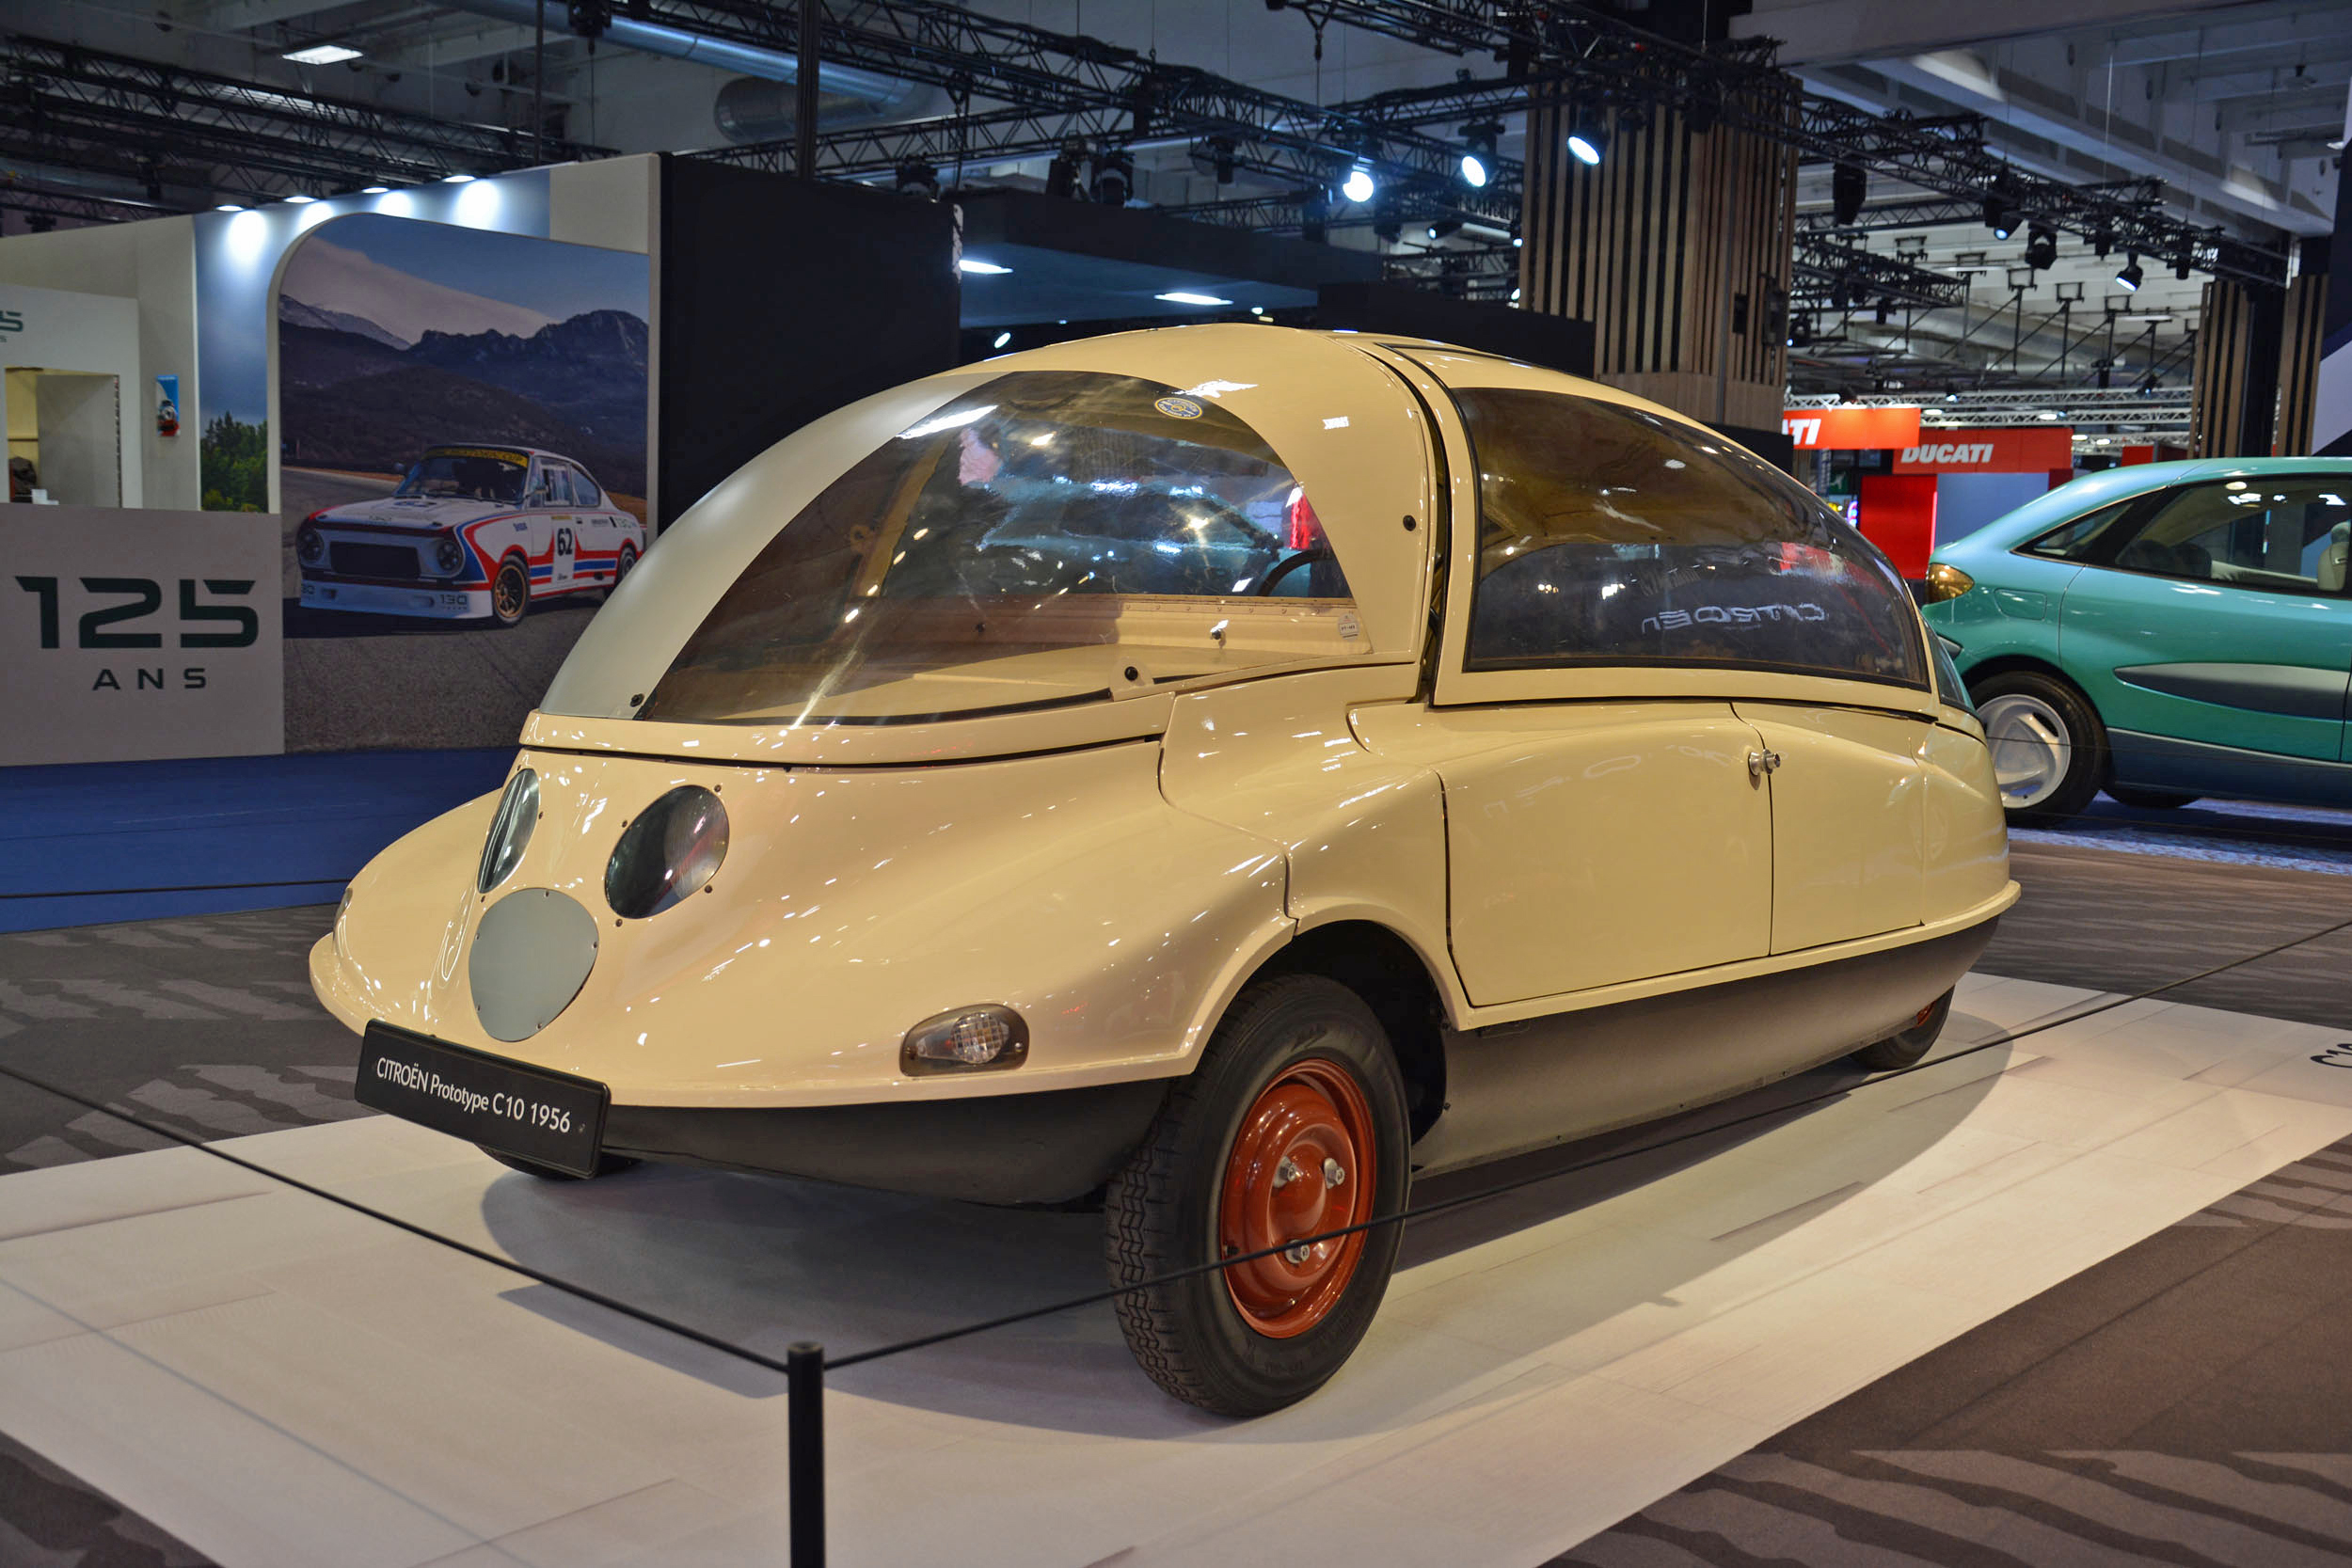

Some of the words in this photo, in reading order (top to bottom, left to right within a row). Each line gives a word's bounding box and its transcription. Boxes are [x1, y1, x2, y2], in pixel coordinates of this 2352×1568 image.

[1900, 443, 1994, 464] DUCATI
[557, 527, 573, 557] 62
[14, 575, 260, 649] 125
[91, 667, 207, 690] ANS
[376, 1056, 429, 1092] CITROËN
[429, 1073, 489, 1114] Prototype
[492, 1092, 525, 1120] C10
[530, 1101, 571, 1132] 1956
